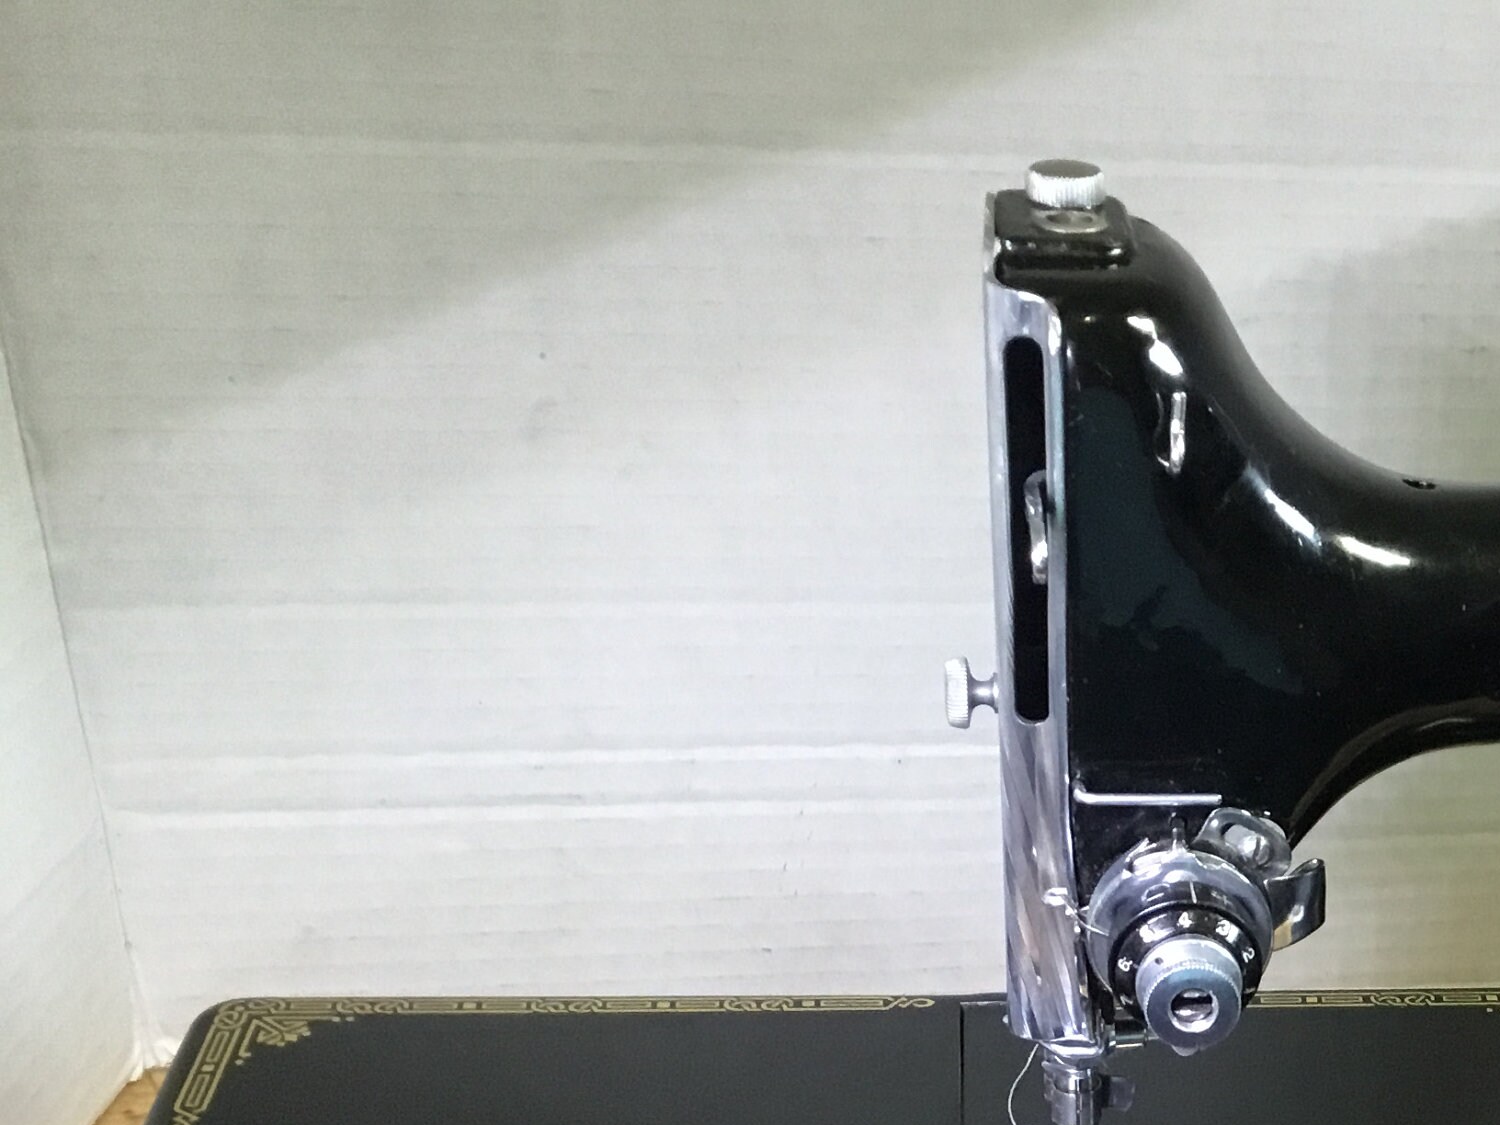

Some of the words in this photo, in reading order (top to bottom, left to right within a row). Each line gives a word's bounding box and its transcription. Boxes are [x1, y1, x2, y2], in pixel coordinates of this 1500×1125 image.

[1117, 956, 1134, 972] 6
[1177, 911, 1193, 928] 4
[1242, 948, 1255, 964] 2
